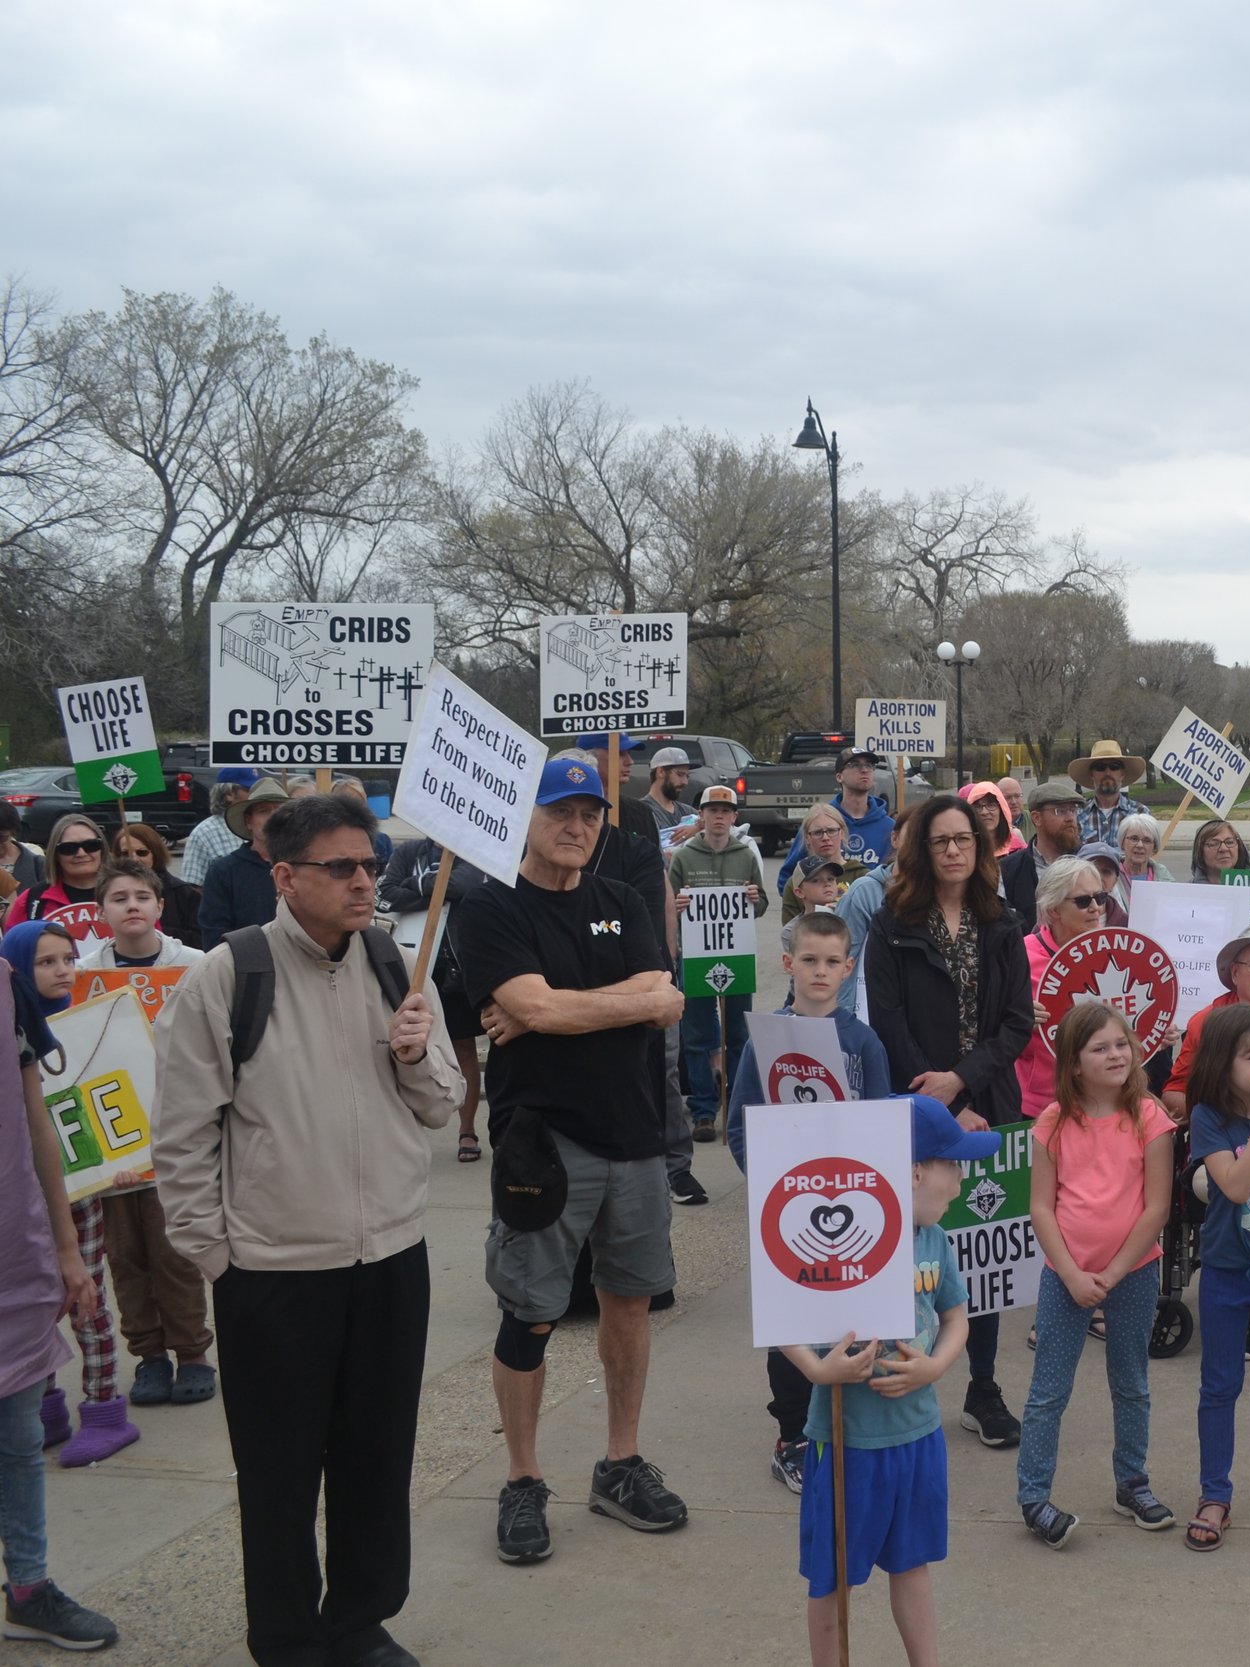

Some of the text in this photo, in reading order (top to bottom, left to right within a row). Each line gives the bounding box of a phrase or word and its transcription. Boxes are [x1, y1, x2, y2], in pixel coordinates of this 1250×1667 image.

[282, 606, 332, 621] EMPTY
[590, 617, 623, 628] EMPTY
[329, 616, 411, 643] CRIBS
[620, 623, 673, 643] CRIBS
[605, 676, 616, 687] to
[67, 684, 143, 724] CHOOSE
[305, 688, 321, 703] to
[553, 689, 649, 713] CROSSES
[867, 700, 936, 717] ABORTION
[92, 718, 131, 752] LIFE
[228, 709, 374, 736] CROSSES
[440, 688, 527, 770] Respect life
[562, 713, 667, 732] CHOOSE LIFE
[879, 719, 921, 736] KILLS
[241, 744, 402, 762] CHOOSE LIFE
[866, 736, 935, 753] CHILDREN
[1183, 718, 1246, 775] ABORTION
[431, 727, 517, 806] from womb
[1184, 742, 1225, 782] KILLS
[1162, 751, 1225, 809] CHILDREN
[422, 768, 509, 843] to the tomb
[686, 892, 749, 922] CHOOSE
[703, 922, 734, 950] LIFE
[1177, 934, 1204, 944] VOTE
[1041, 934, 1174, 996] WE STAND ON
[1173, 960, 1211, 972] RO-LIFE
[775, 1062, 827, 1078] PRO-LIFE
[783, 1171, 877, 1192] PRO-LIFE
[946, 1220, 1036, 1273] HOOSE
[967, 1268, 1014, 1314] LIFE
